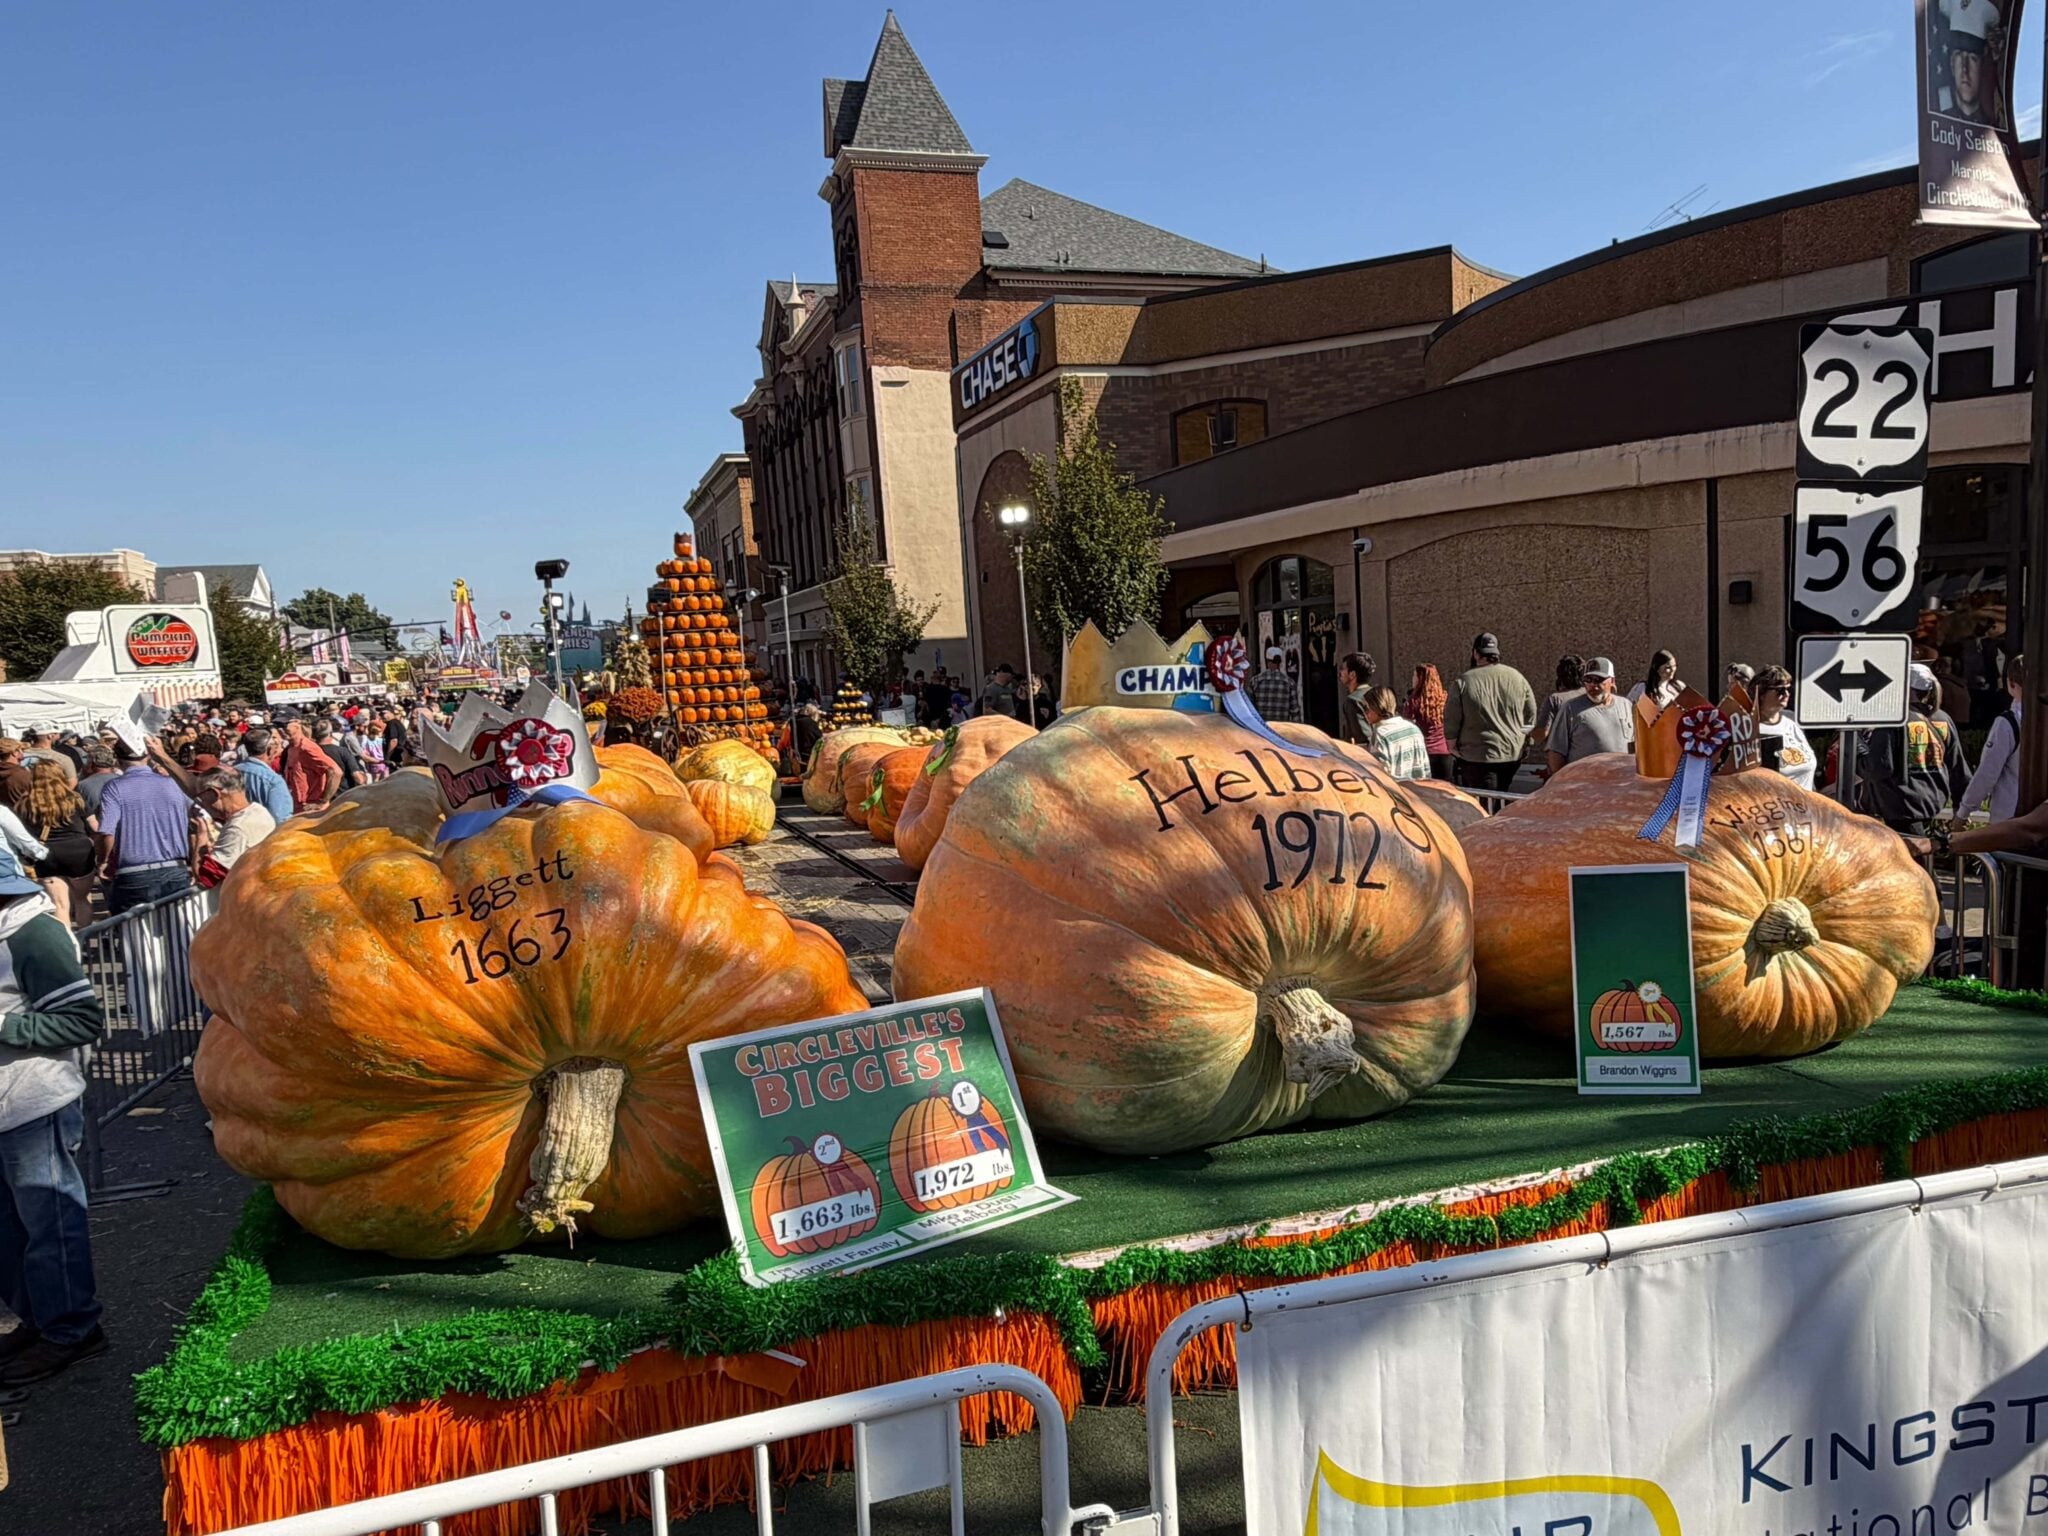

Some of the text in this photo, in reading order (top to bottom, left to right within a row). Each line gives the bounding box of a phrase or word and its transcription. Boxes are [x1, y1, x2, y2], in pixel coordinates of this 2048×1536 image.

[1931, 120, 1961, 152] Cody
[961, 336, 1018, 410] CHASE
[1811, 358, 1918, 440] 22
[1803, 513, 1907, 593] 56
[137, 646, 190, 656] WAFFLES
[1128, 748, 1431, 853] Helberg
[1251, 808, 1387, 891] 1972
[409, 849, 574, 923] Liggett
[450, 908, 572, 984] 1663
[735, 1007, 965, 1076] CIRCLEVILLE'S
[1604, 1026, 1644, 1040] 1,567
[752, 1036, 965, 1119] BIGGEST
[957, 1084, 972, 1108] 1st
[1600, 1065, 1677, 1078] Brandon Wiggins
[818, 1138, 835, 1156] 2nd
[919, 1161, 975, 1197] 1,972
[778, 1202, 874, 1240] 1,663 lbs.
[917, 1211, 959, 1229] Mike
[848, 1238, 901, 1260] Family
[1741, 1395, 2048, 1504] KINGST
